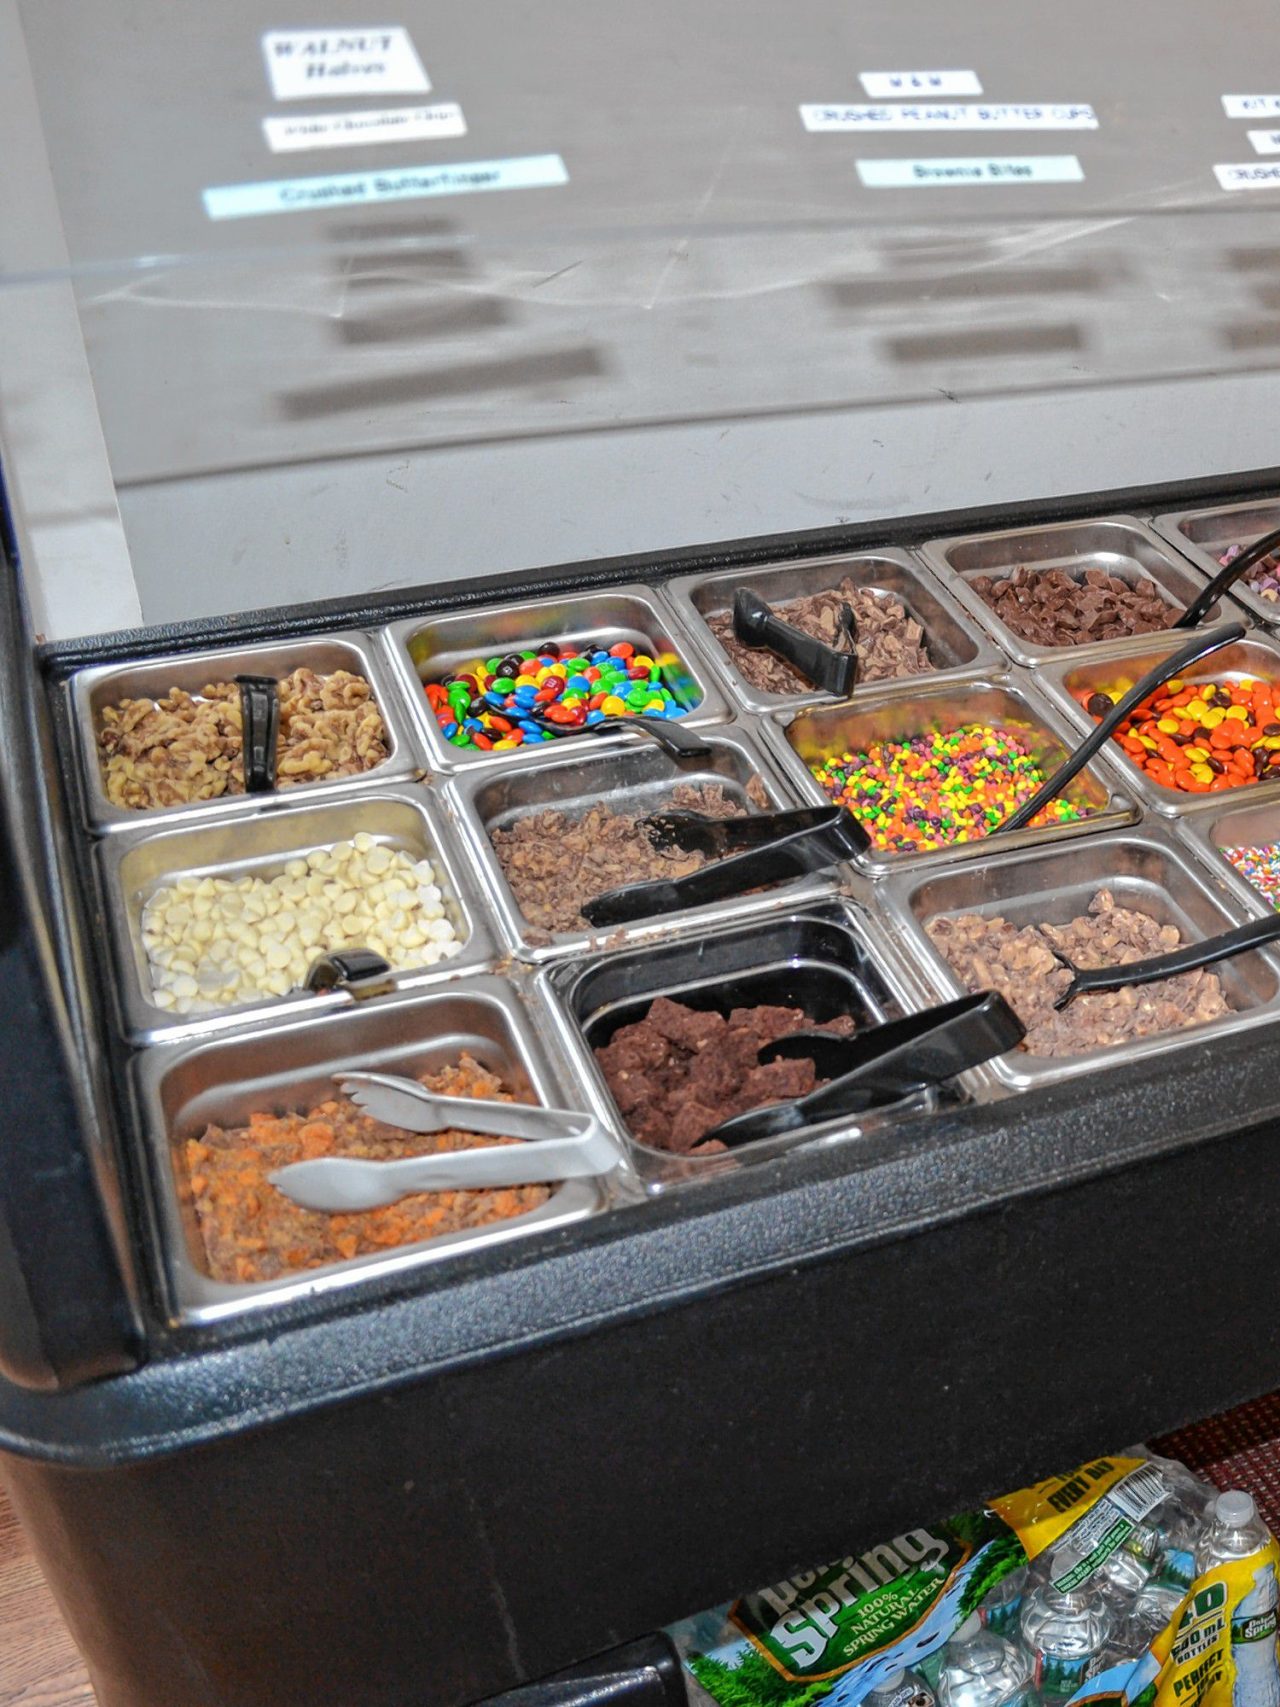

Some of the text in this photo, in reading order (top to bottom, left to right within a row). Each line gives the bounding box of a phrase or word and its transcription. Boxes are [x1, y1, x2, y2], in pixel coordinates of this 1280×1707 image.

[274, 35, 394, 57] WALNUT
[813, 108, 893, 121] CRUSHED
[900, 107, 968, 120] PEANUT
[977, 107, 1044, 120] BUTTER
[769, 1527, 950, 1669] Spring
[843, 1576, 945, 1657] SPRING WATER
[850, 1587, 920, 1635] NATURAL
[858, 1591, 898, 1618] 100%
[1173, 1647, 1225, 1698] PERFECT
